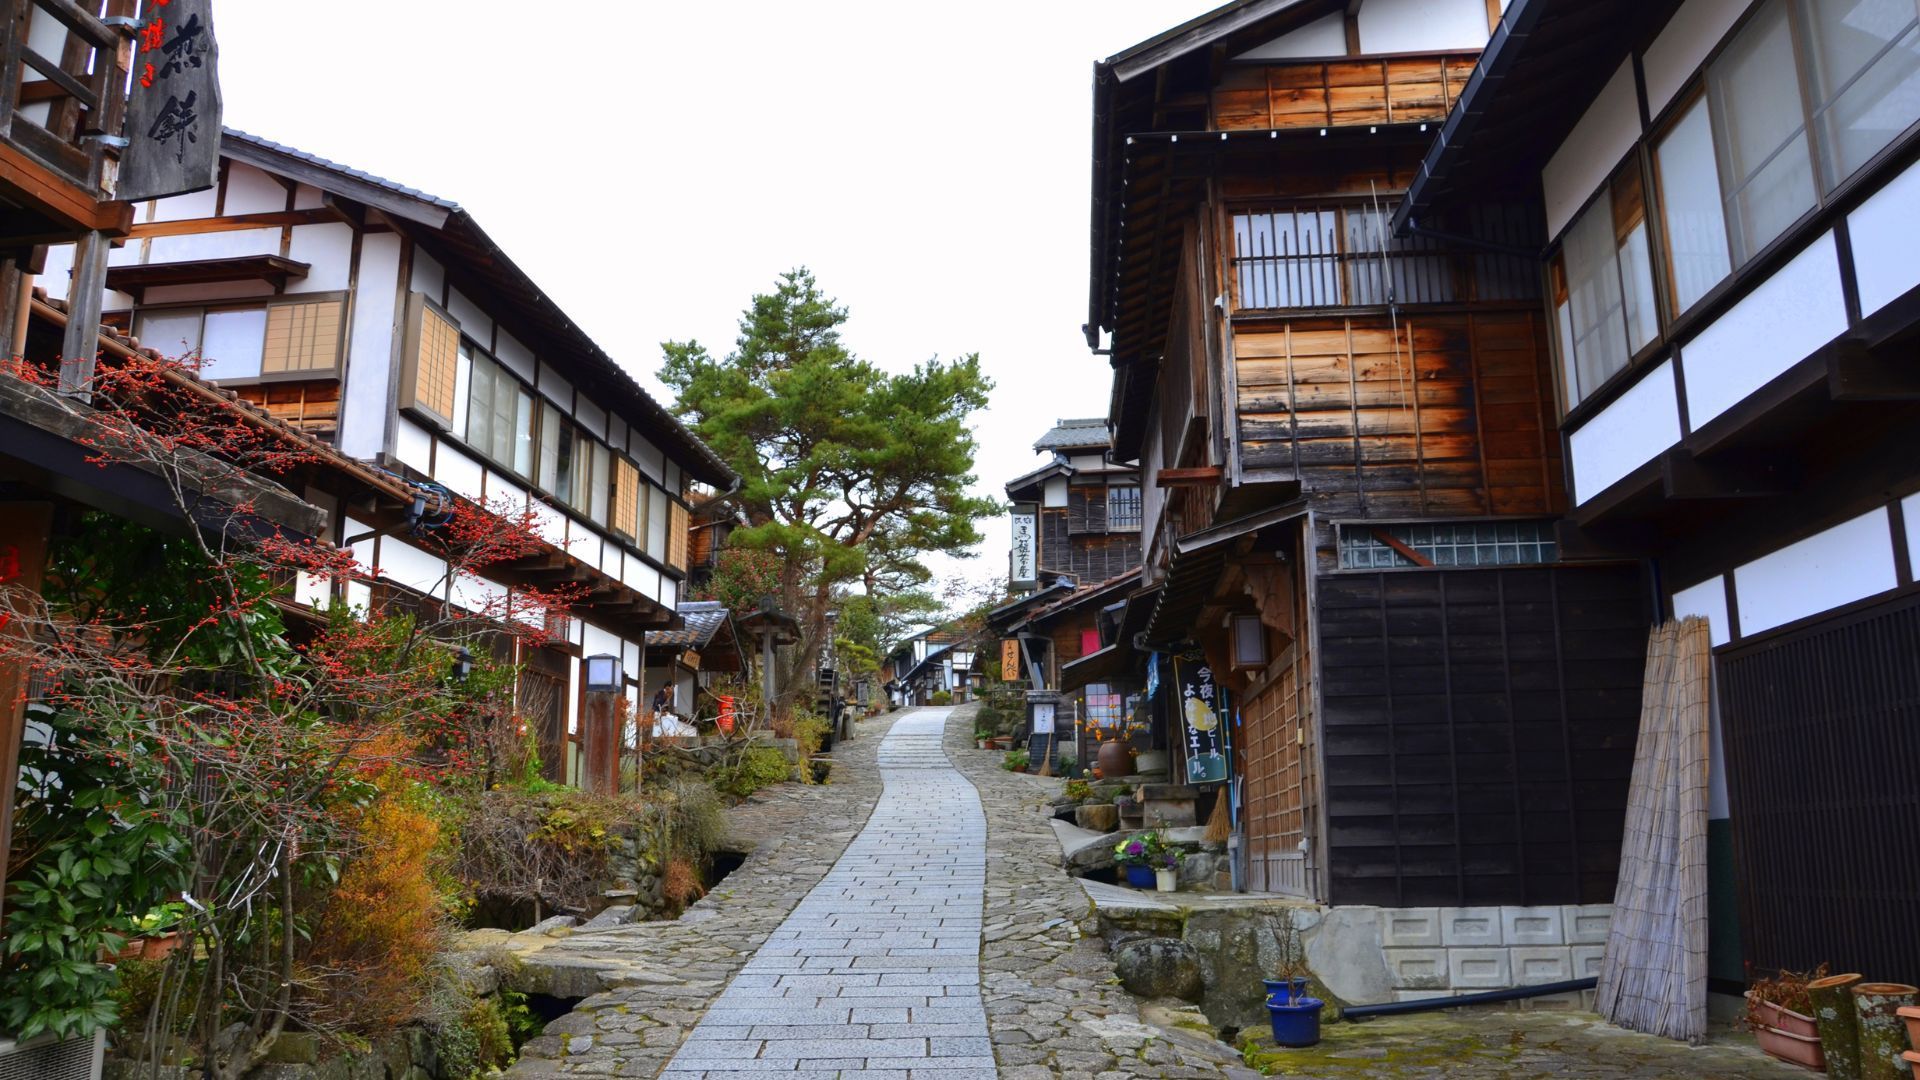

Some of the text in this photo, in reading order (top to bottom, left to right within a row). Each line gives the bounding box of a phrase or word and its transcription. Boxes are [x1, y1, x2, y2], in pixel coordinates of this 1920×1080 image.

[148, 13, 204, 163] 煎餅
[1014, 525, 1032, 579] 馬籠茶屋
